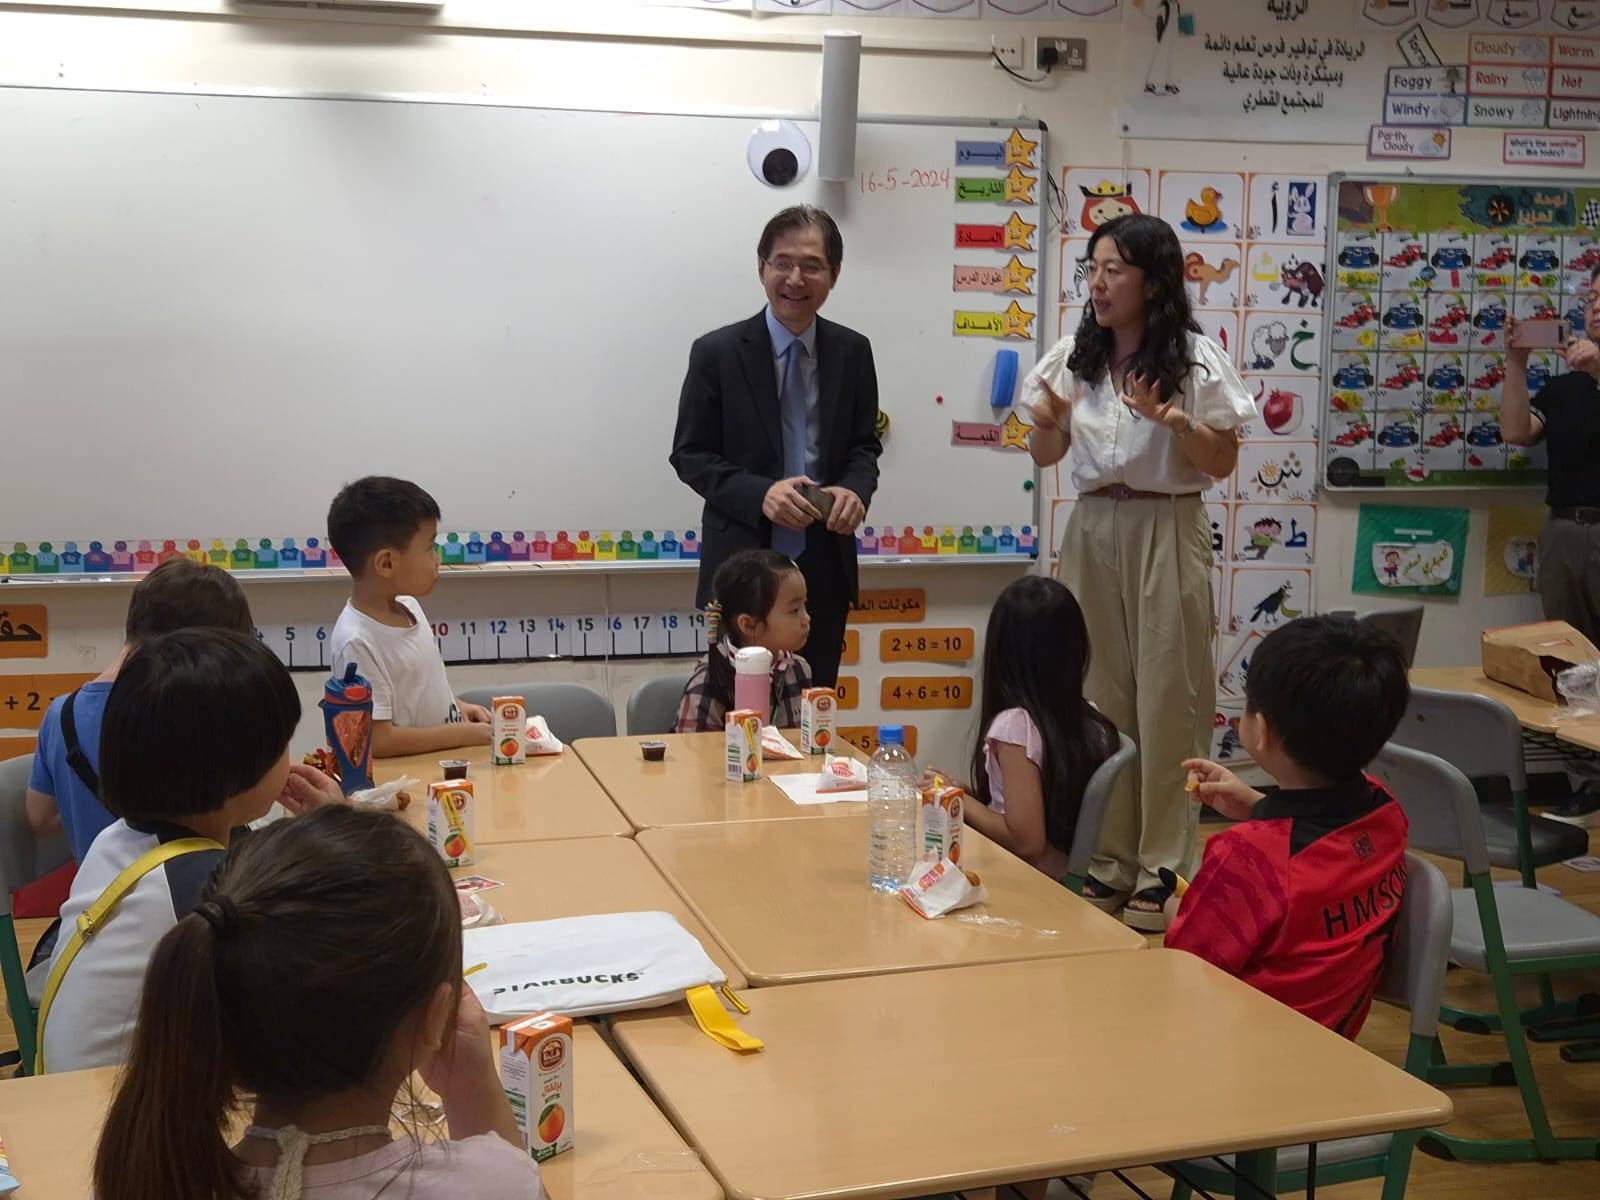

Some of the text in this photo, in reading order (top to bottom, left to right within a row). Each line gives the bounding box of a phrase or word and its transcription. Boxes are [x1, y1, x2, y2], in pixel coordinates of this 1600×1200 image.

[1474, 41, 1595, 58] Cloudy Warm
[1394, 75, 1433, 91] Foggy
[1475, 71, 1509, 88] Rainy
[1561, 75, 1583, 89] Hot
[1391, 102, 1431, 118] Windy
[1473, 105, 1515, 121] Snowy
[1377, 130, 1408, 142] Partly
[1383, 141, 1415, 153] Cloudy
[285, 626, 296, 641] 5
[316, 626, 326, 641] 6
[431, 622, 449, 637] 10
[460, 621, 477, 636] 11
[490, 620, 508, 635] 12
[518, 619, 536, 633] 13
[548, 618, 565, 632] 14
[577, 617, 594, 632] 15
[606, 616, 623, 631] 16
[633, 615, 650, 630] 17
[661, 614, 678, 630] 18
[689, 614, 705, 628] 19
[892, 638, 901, 652] 2
[905, 640, 913, 650] +
[917, 638, 927, 652] 8
[944, 637, 962, 651] 10
[893, 686, 902, 700] 4
[906, 688, 914, 698] +
[918, 686, 927, 700] 6
[943, 686, 961, 700] 10
[27, 692, 41, 711] 2
[861, 735, 870, 749] 5
